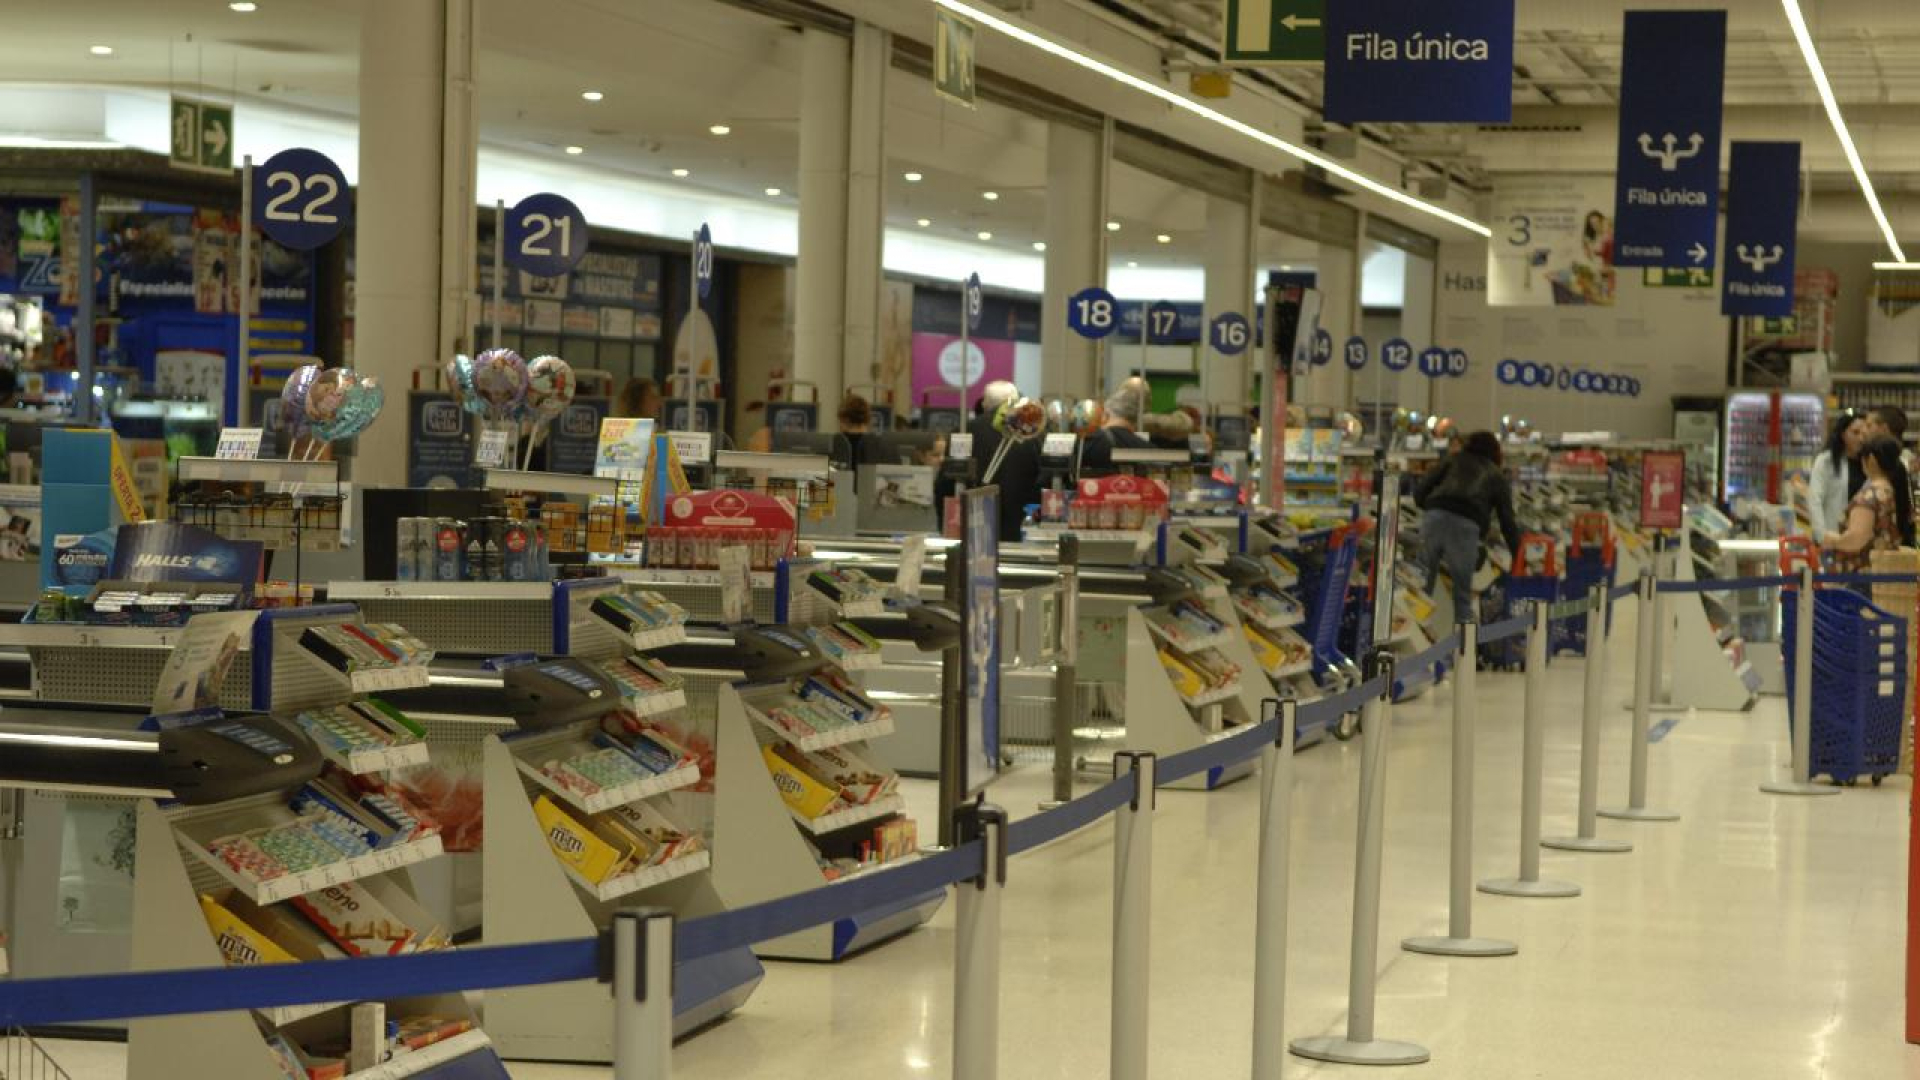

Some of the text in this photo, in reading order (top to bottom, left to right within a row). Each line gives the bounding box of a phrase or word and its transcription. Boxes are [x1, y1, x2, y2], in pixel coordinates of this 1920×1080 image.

[1346, 31, 1488, 61] Fila única
[265, 170, 339, 223] 22
[1627, 188, 1707, 206] Fila única
[521, 213, 571, 256] 21
[1508, 215, 1531, 246] 3
[698, 242, 711, 278] 20
[1622, 245, 1663, 257] Entrada
[1728, 282, 1785, 297] Fila única
[968, 286, 980, 316] 19
[1077, 299, 1113, 328] 18
[1152, 310, 1176, 336] 17
[1217, 322, 1246, 346] 16
[1349, 344, 1364, 363] 13
[1386, 345, 1408, 364] 12
[1425, 353, 1444, 371] 11
[1449, 354, 1465, 371] 10
[1502, 363, 1516, 380] 9
[1523, 366, 1536, 382] 8
[136, 554, 193, 568] HALLS
